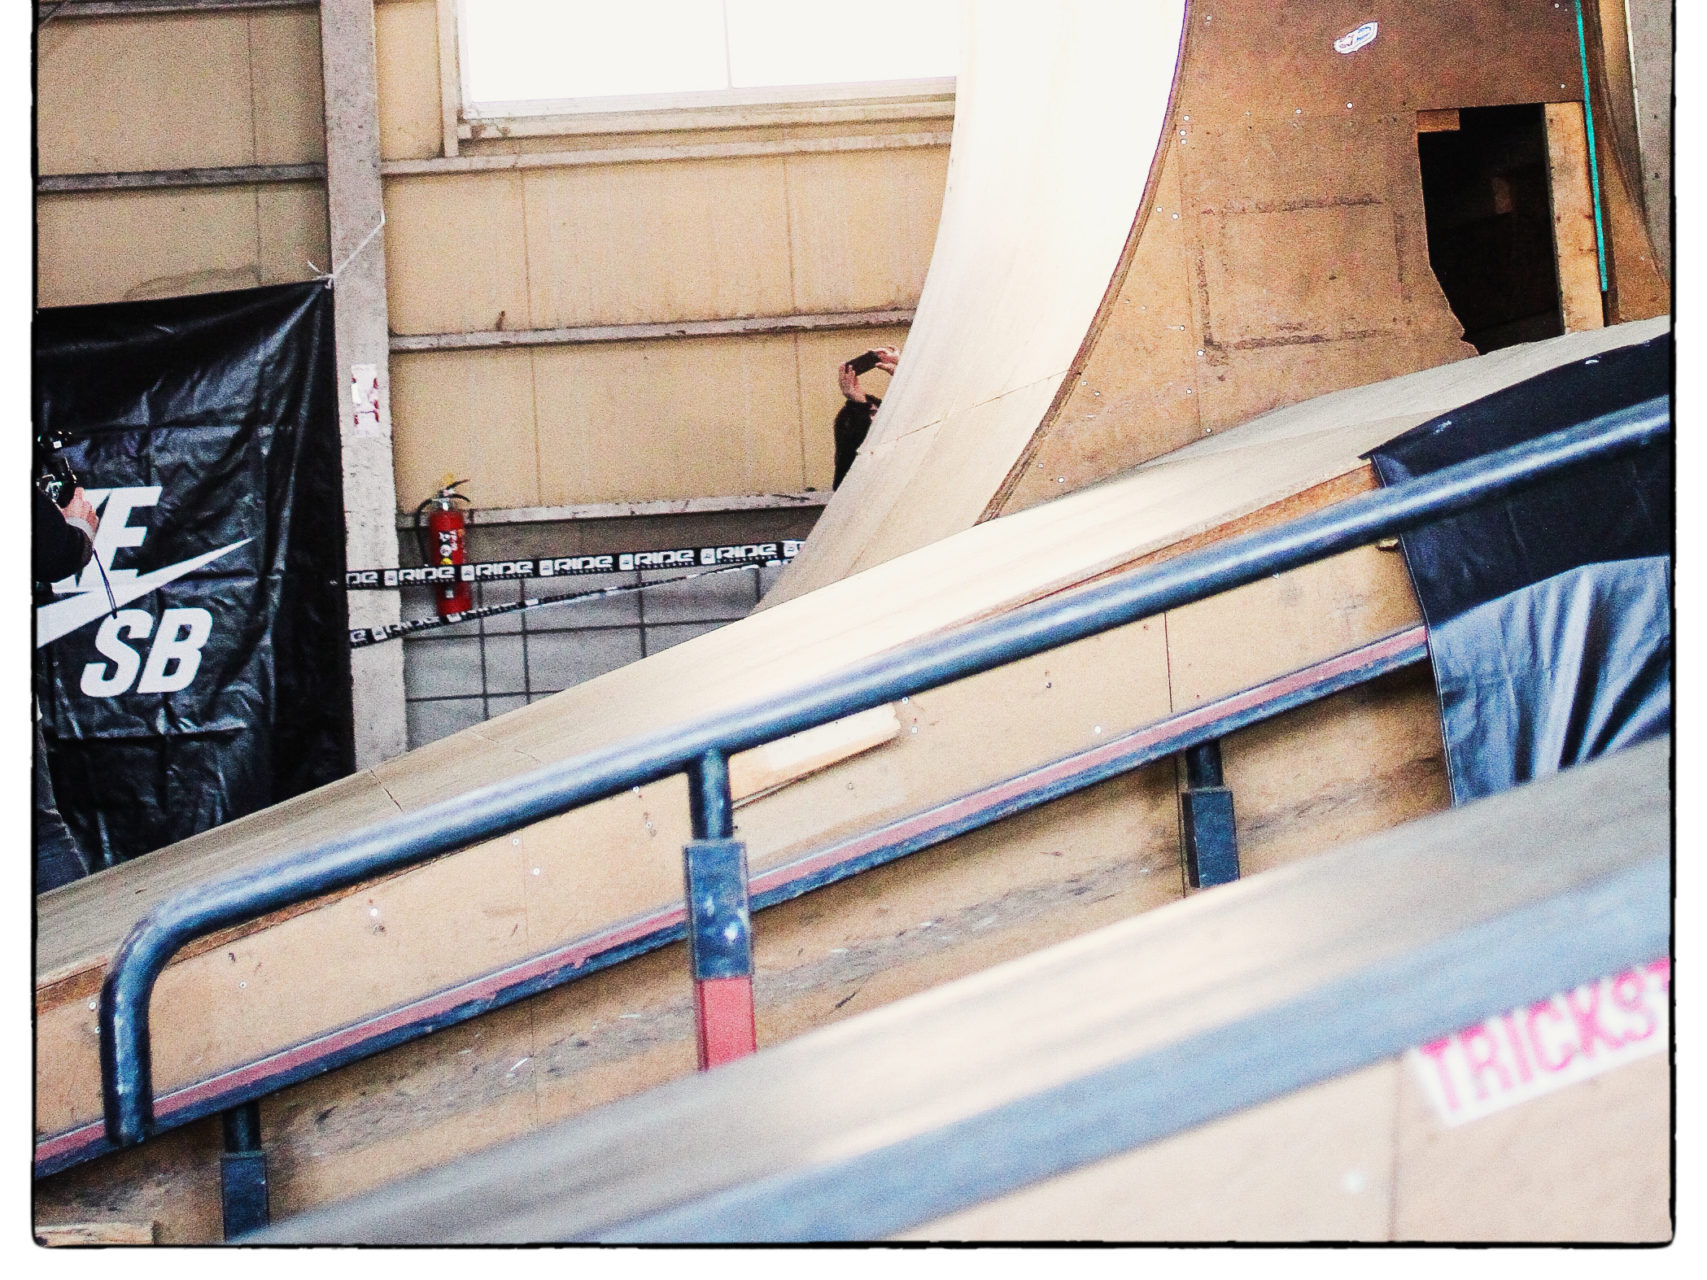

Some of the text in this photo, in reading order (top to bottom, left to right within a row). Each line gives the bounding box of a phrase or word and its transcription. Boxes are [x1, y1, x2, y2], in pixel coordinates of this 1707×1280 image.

[399, 566, 455, 581] RIDE
[475, 561, 533, 577] RIDE
[554, 555, 613, 571] RIDE
[634, 550, 694, 566] RIDE
[716, 543, 777, 559] RIDE
[79, 607, 213, 698] SB
